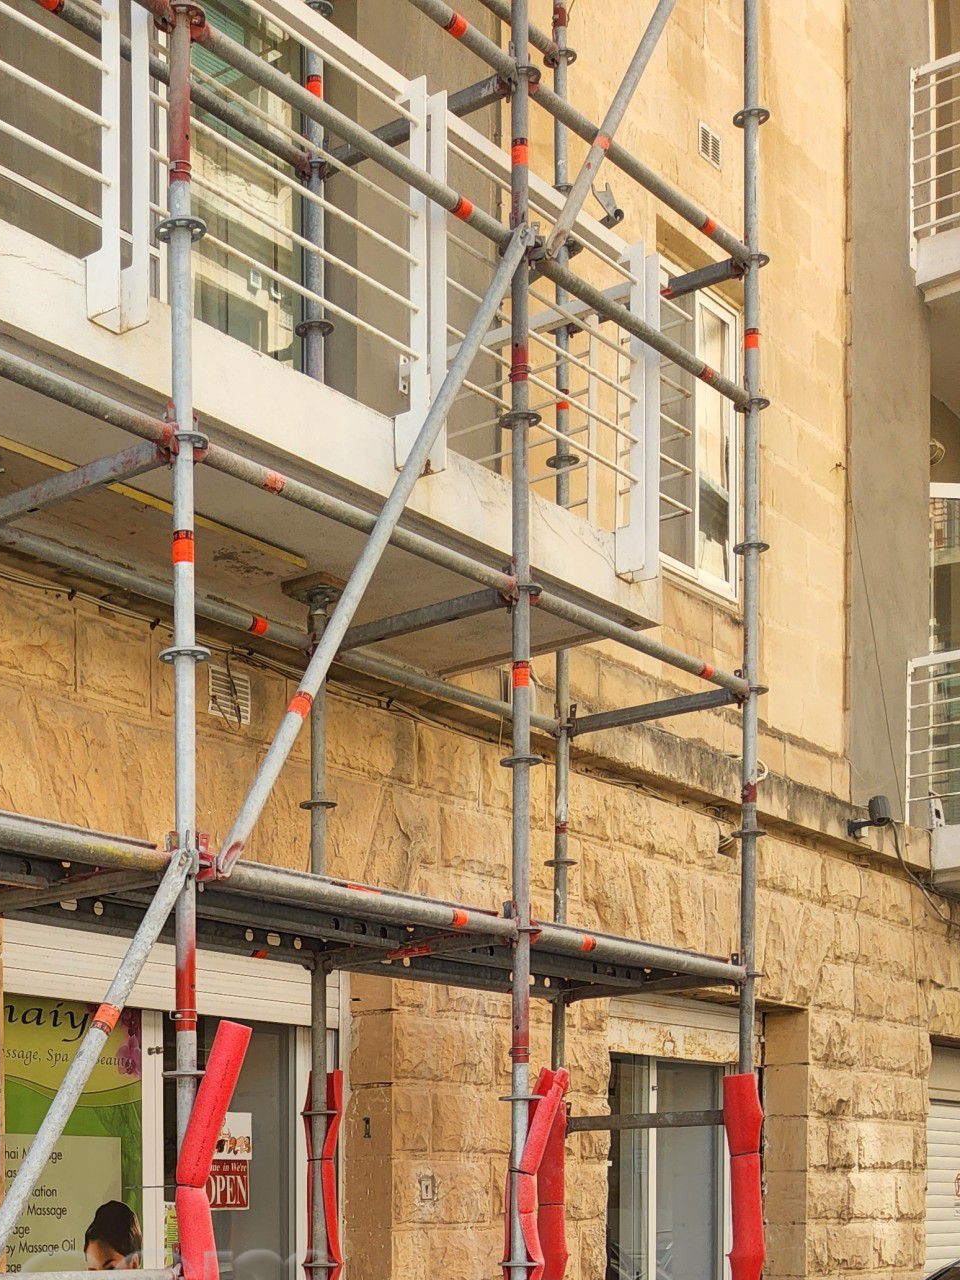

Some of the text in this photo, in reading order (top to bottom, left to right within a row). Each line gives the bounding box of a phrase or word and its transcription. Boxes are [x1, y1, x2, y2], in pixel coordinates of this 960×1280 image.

[2, 1050, 41, 1066] ssage,
[47, 1048, 69, 1068] Spa
[4, 1144, 19, 1160] hai
[222, 1163, 230, 1172] in
[231, 1162, 247, 1172] We're
[31, 1185, 57, 1198] ation
[208, 1175, 247, 1205] OPEN
[27, 1204, 68, 1220] Massage
[18, 1241, 60, 1257] Massage
[61, 1237, 76, 1252] Oil
